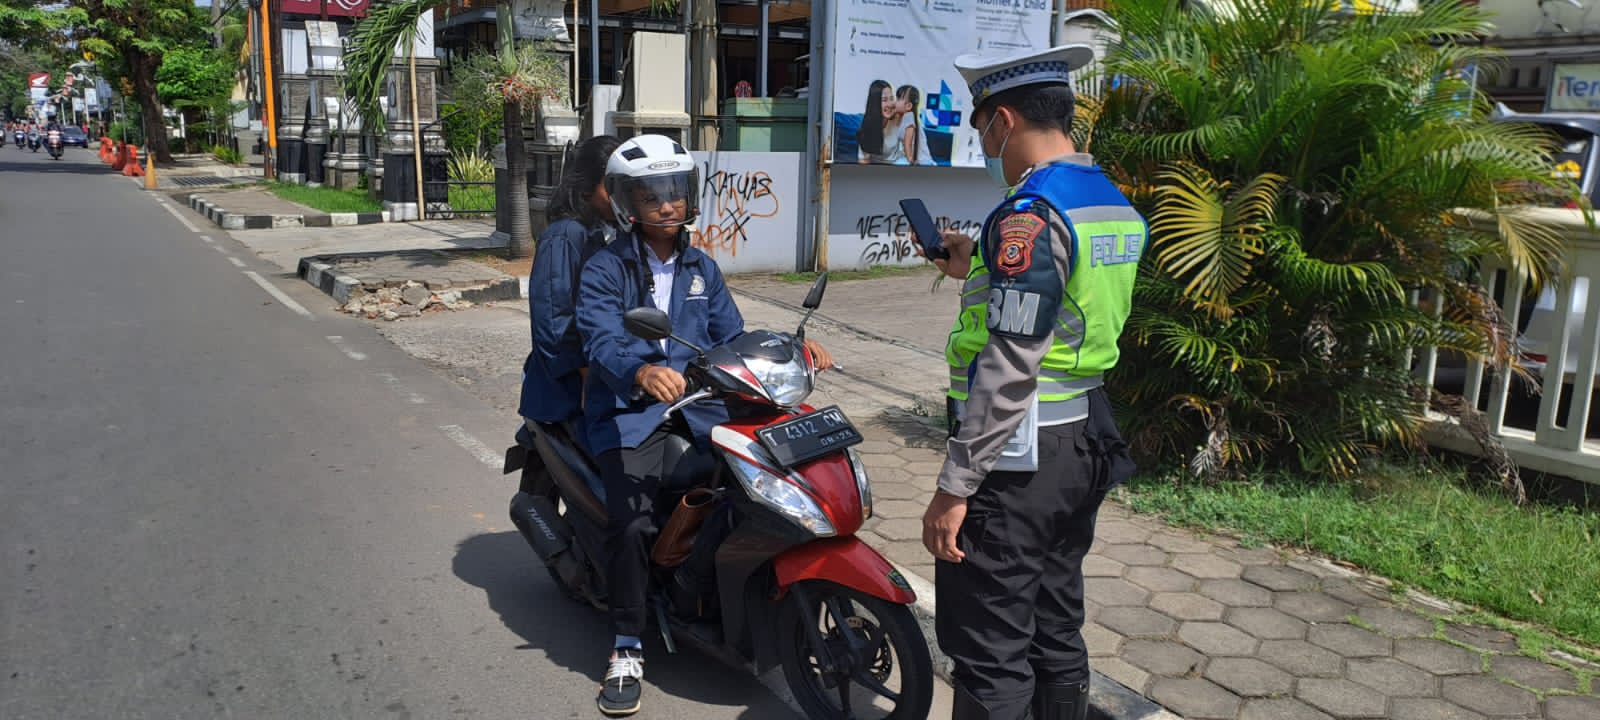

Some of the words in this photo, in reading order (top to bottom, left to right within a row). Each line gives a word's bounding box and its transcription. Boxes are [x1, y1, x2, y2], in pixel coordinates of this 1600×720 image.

[764, 431, 778, 447] T
[784, 421, 818, 440] 4312
[823, 411, 845, 427] CM
[527, 506, 557, 542] TURBO
